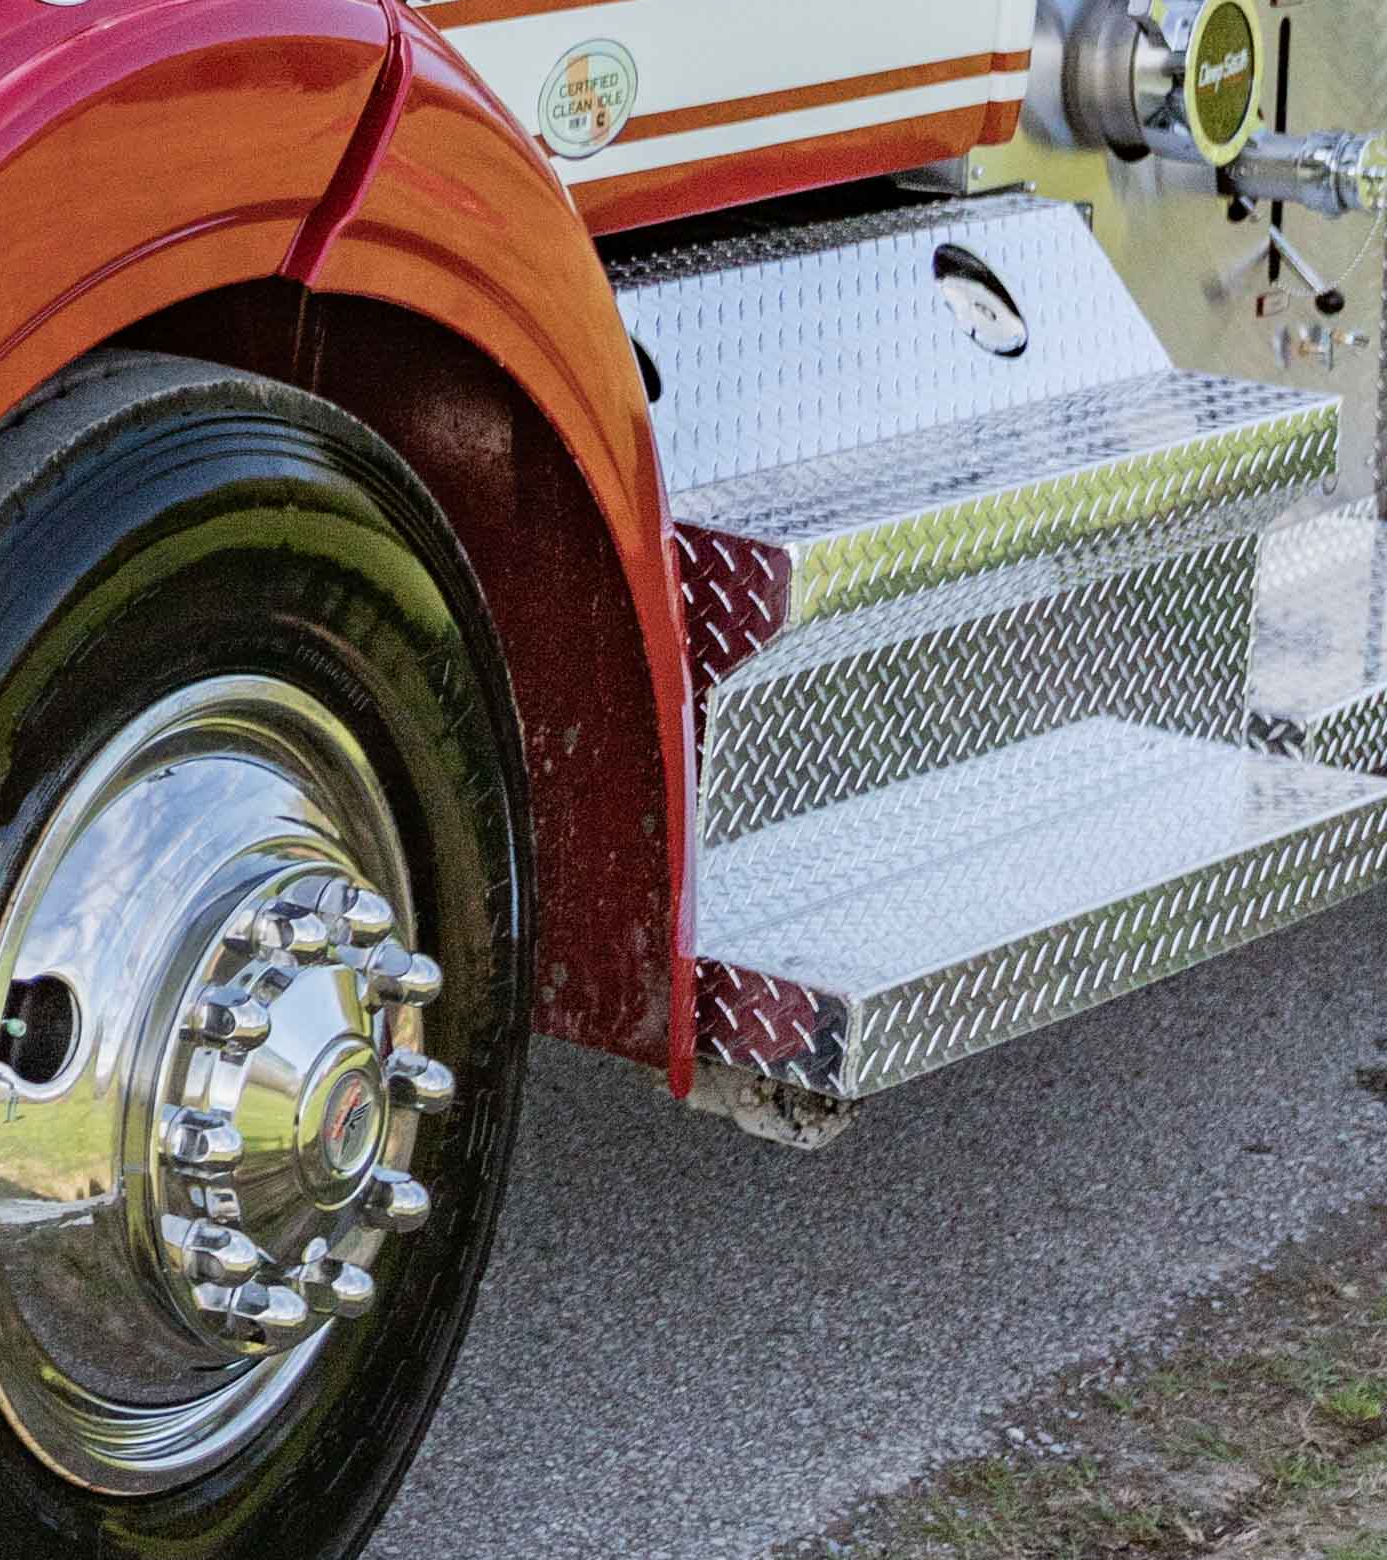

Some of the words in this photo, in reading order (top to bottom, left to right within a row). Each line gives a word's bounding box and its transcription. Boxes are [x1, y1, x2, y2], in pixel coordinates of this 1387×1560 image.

[559, 73, 619, 98] CERTIFIED
[553, 99, 592, 119] CLEAN
[597, 90, 623, 108] IDLE
